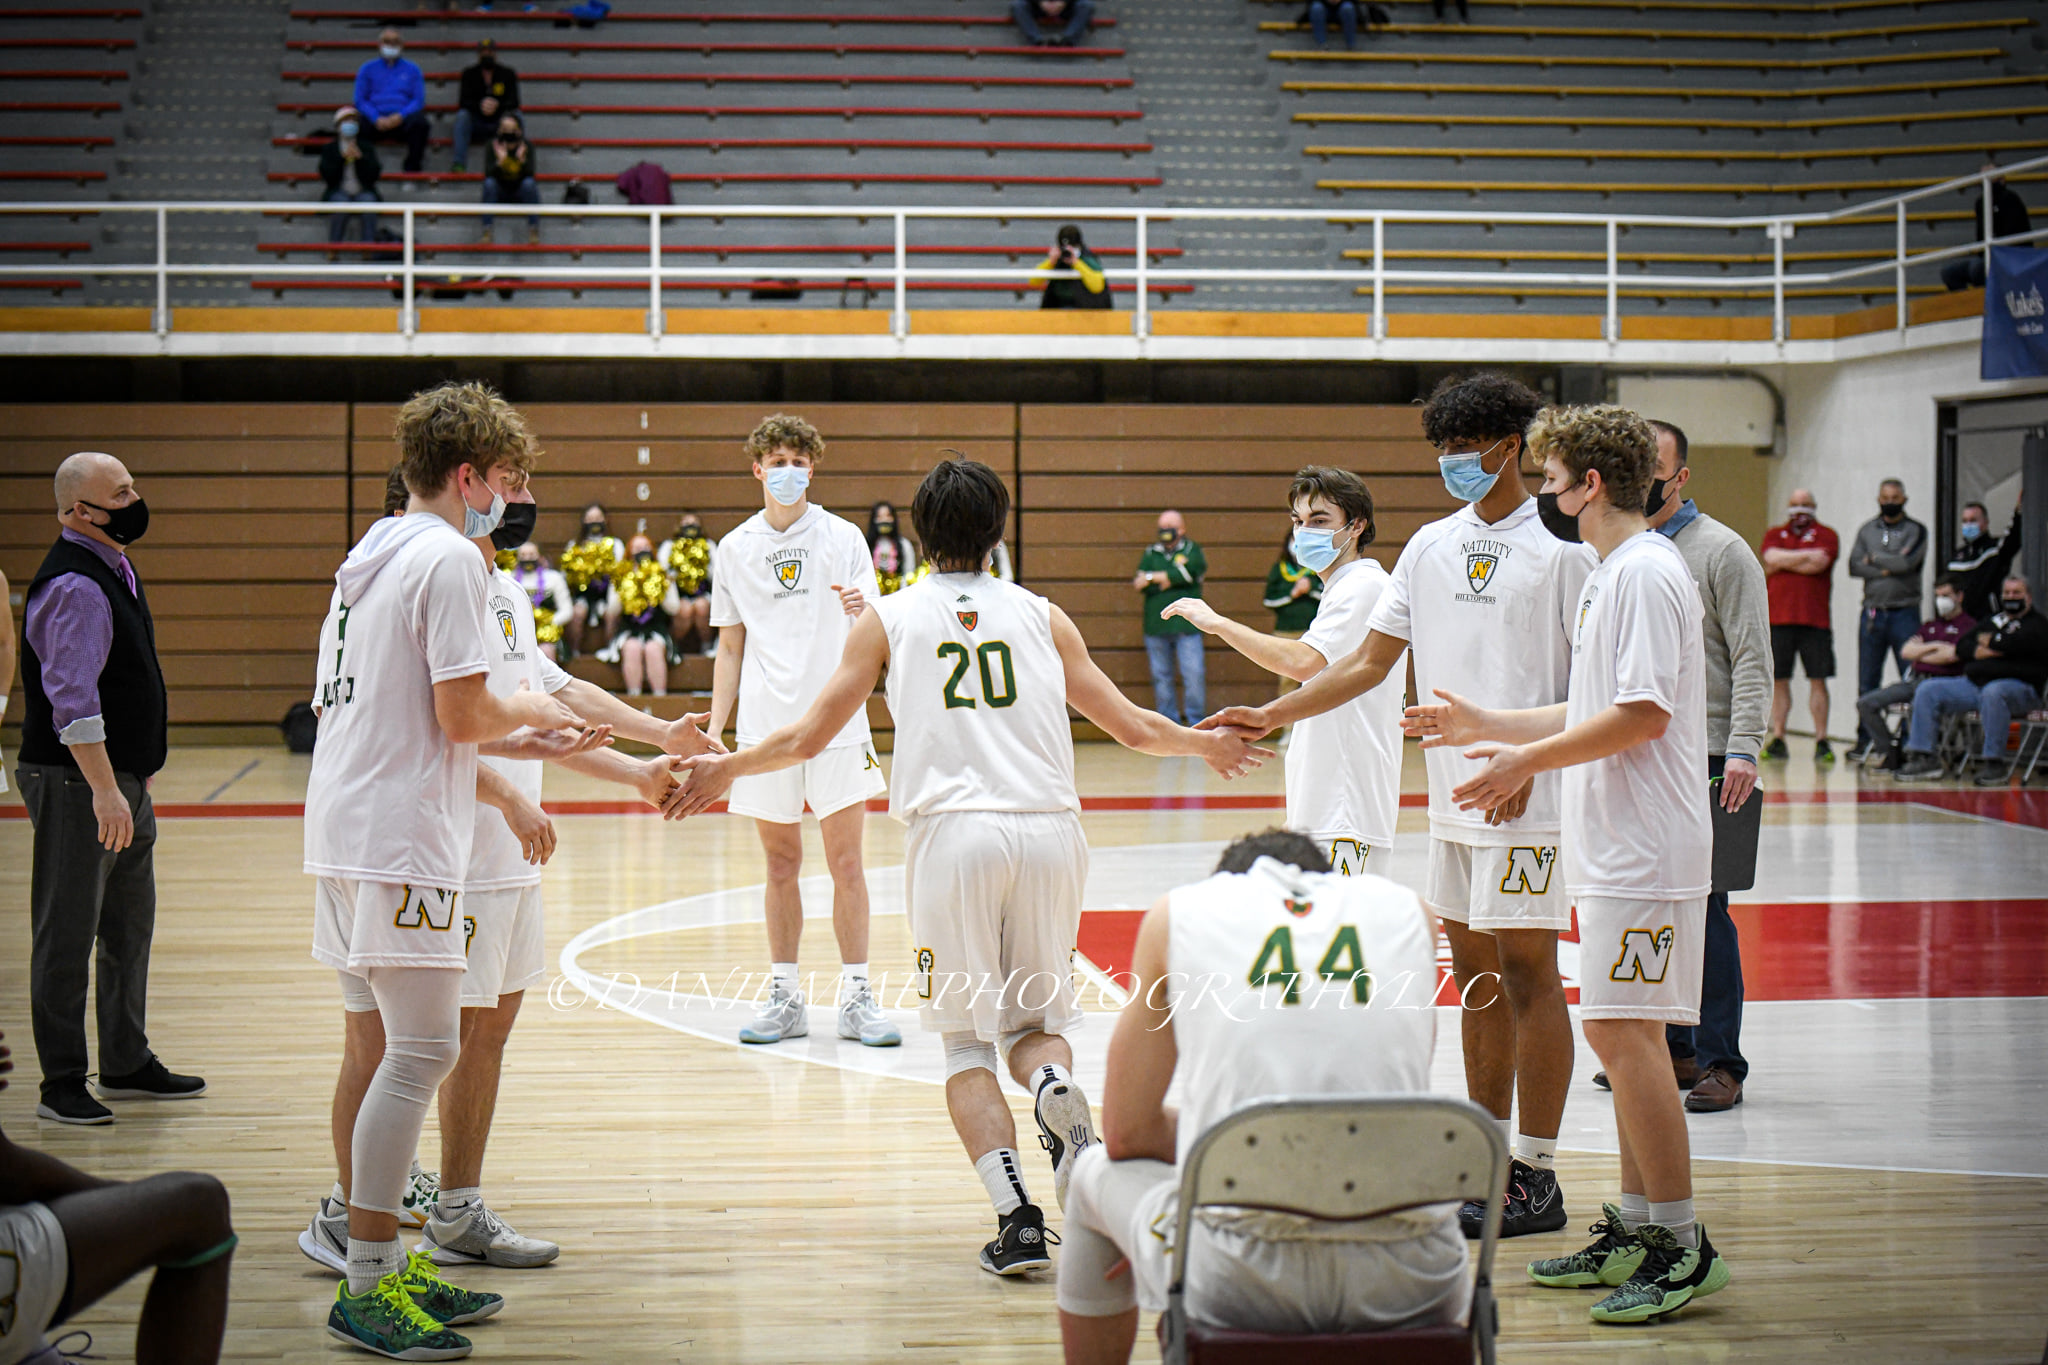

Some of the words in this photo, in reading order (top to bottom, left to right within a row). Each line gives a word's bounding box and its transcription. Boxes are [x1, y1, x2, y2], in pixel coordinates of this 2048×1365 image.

[765, 548, 809, 565] NATIVITY
[1460, 539, 1512, 559] NATIVITY
[1455, 593, 1496, 604] HILLTOPPERS
[936, 640, 1018, 711] 20
[1247, 924, 1370, 1005] 44
